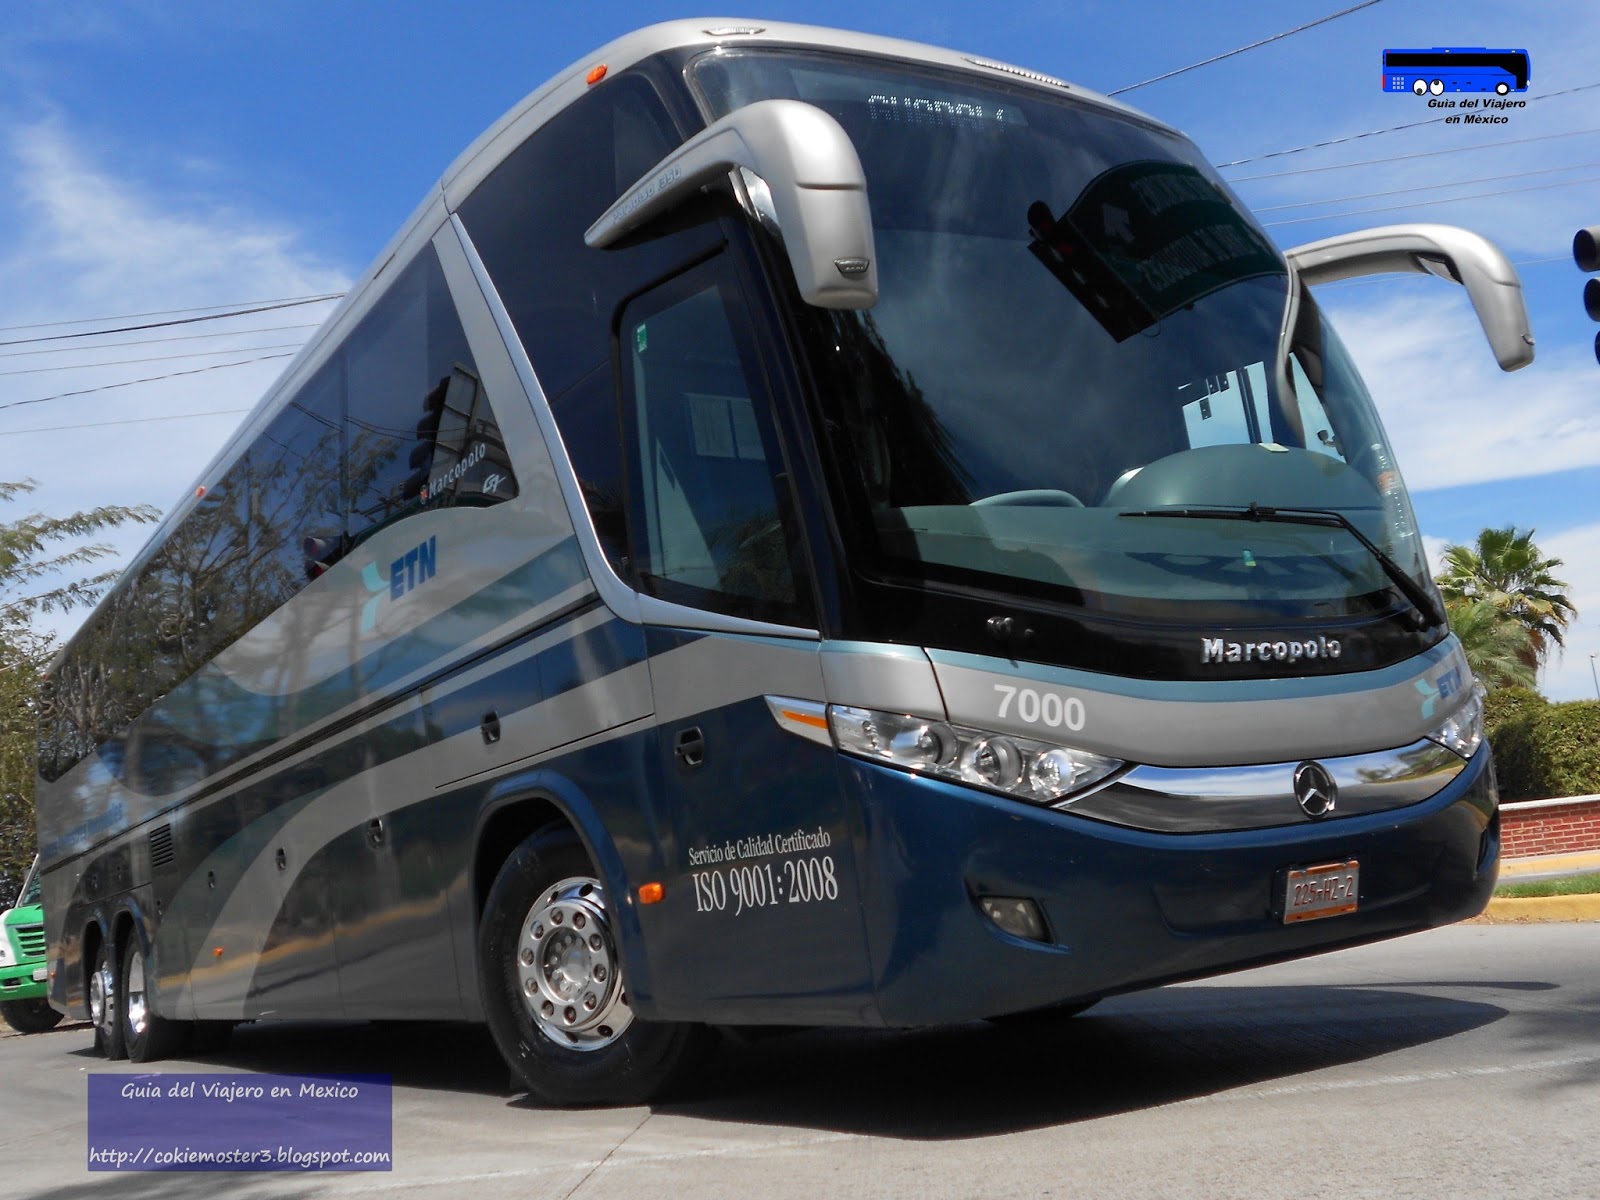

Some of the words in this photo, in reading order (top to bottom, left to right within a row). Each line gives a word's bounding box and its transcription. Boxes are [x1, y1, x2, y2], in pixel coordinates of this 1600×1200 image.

[428, 443, 486, 498] Marcopolo
[390, 534, 436, 601] ETN
[1201, 635, 1342, 664] Marcopolo
[993, 684, 1086, 732] 7000
[688, 844, 724, 866] Servicio
[724, 840, 736, 861] de
[736, 833, 774, 859] Calidad
[774, 826, 831, 854] Certificado
[692, 870, 727, 912] ISO
[1293, 875, 1354, 907] 225-HZ-2
